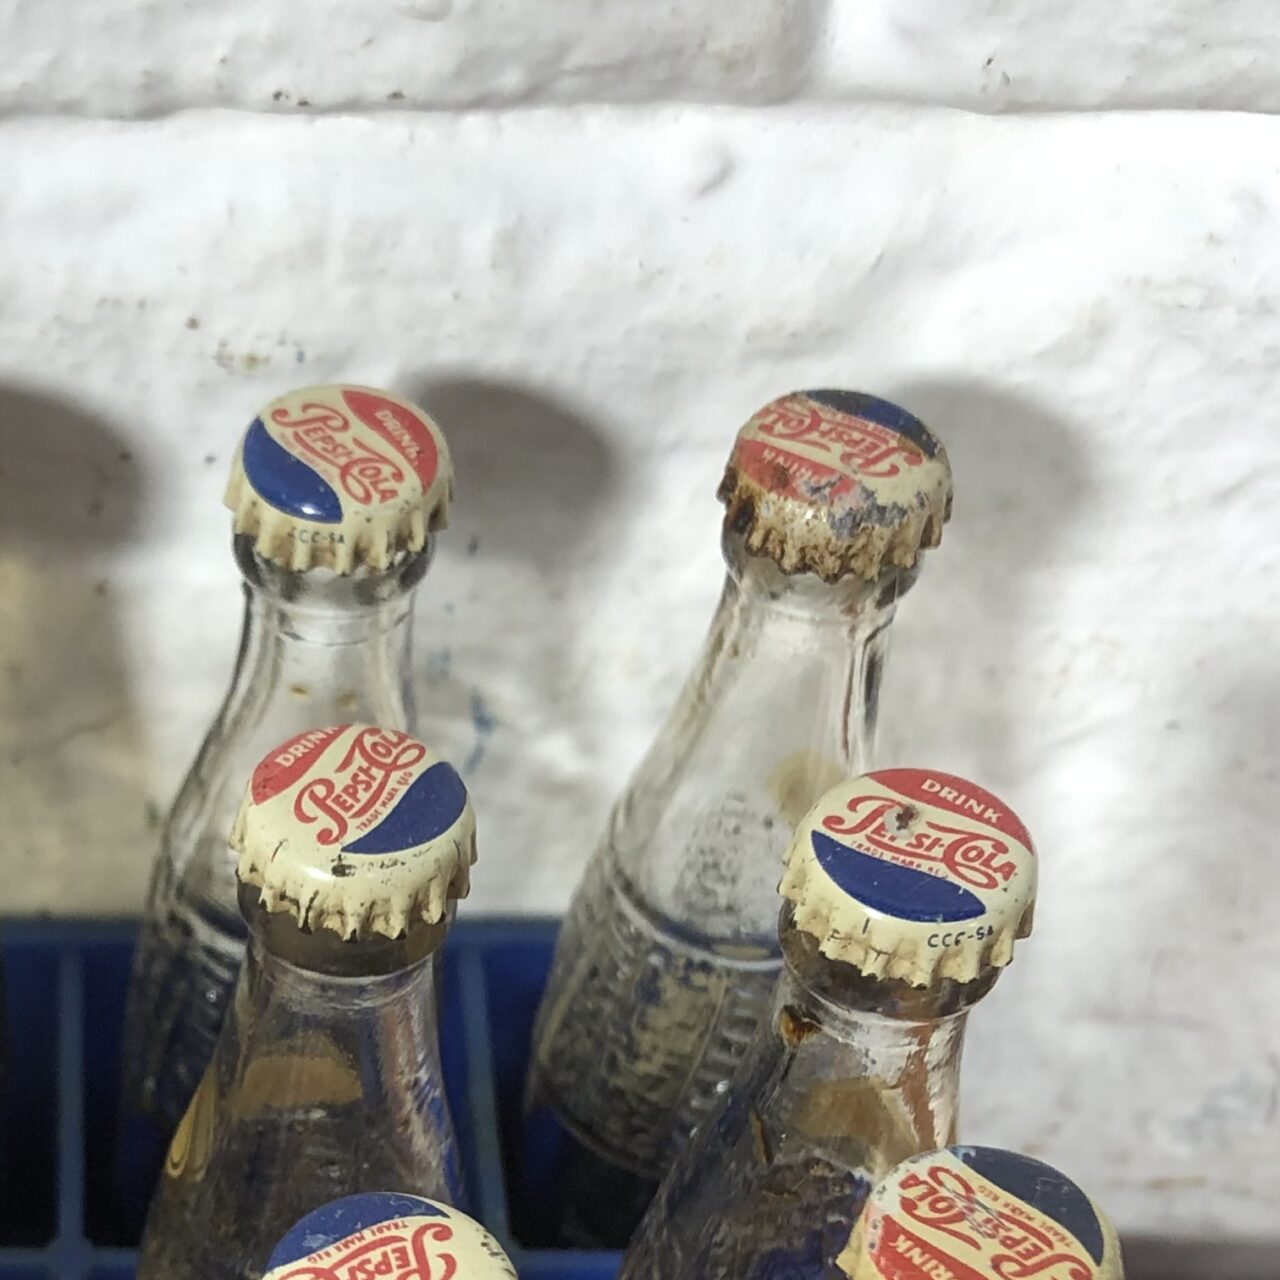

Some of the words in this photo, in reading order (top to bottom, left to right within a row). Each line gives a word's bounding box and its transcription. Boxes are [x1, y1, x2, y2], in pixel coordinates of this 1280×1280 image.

[271, 403, 404, 505] PEPSI-COLA
[375, 409, 422, 467] DRINK
[275, 725, 340, 768] DRINK
[293, 727, 426, 846] PEPSI-COLA
[920, 779, 1003, 824] DRINK
[822, 795, 1017, 889] PESI-COLA
[334, 1234, 365, 1252] MARK
[370, 1219, 407, 1236] TRADE
